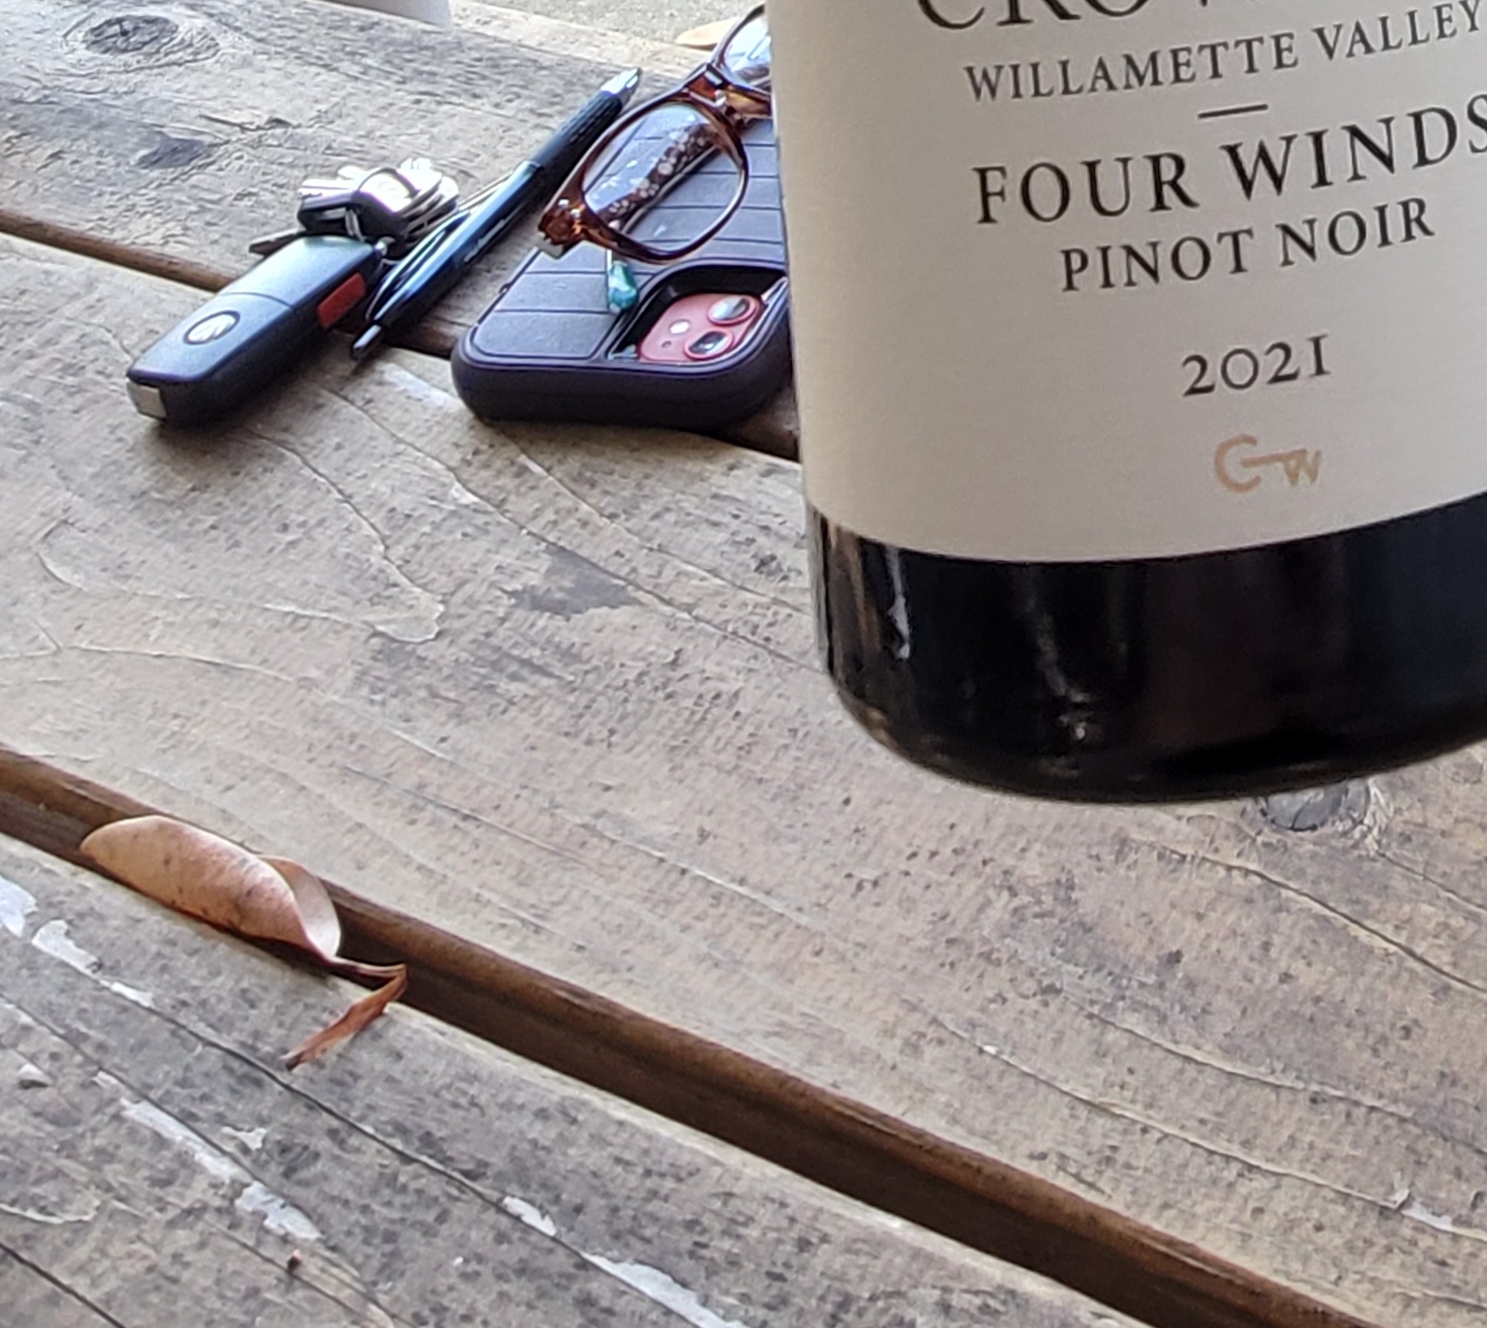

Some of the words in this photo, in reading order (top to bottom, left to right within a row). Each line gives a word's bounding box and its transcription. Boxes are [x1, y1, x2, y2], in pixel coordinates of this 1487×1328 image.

[964, 33, 1299, 103] WILLAMETTE
[973, 153, 1201, 226] FOUR
[1060, 228, 1255, 294] PINOT
[1276, 198, 1436, 268] NOIR
[1182, 334, 1331, 398] 2021
